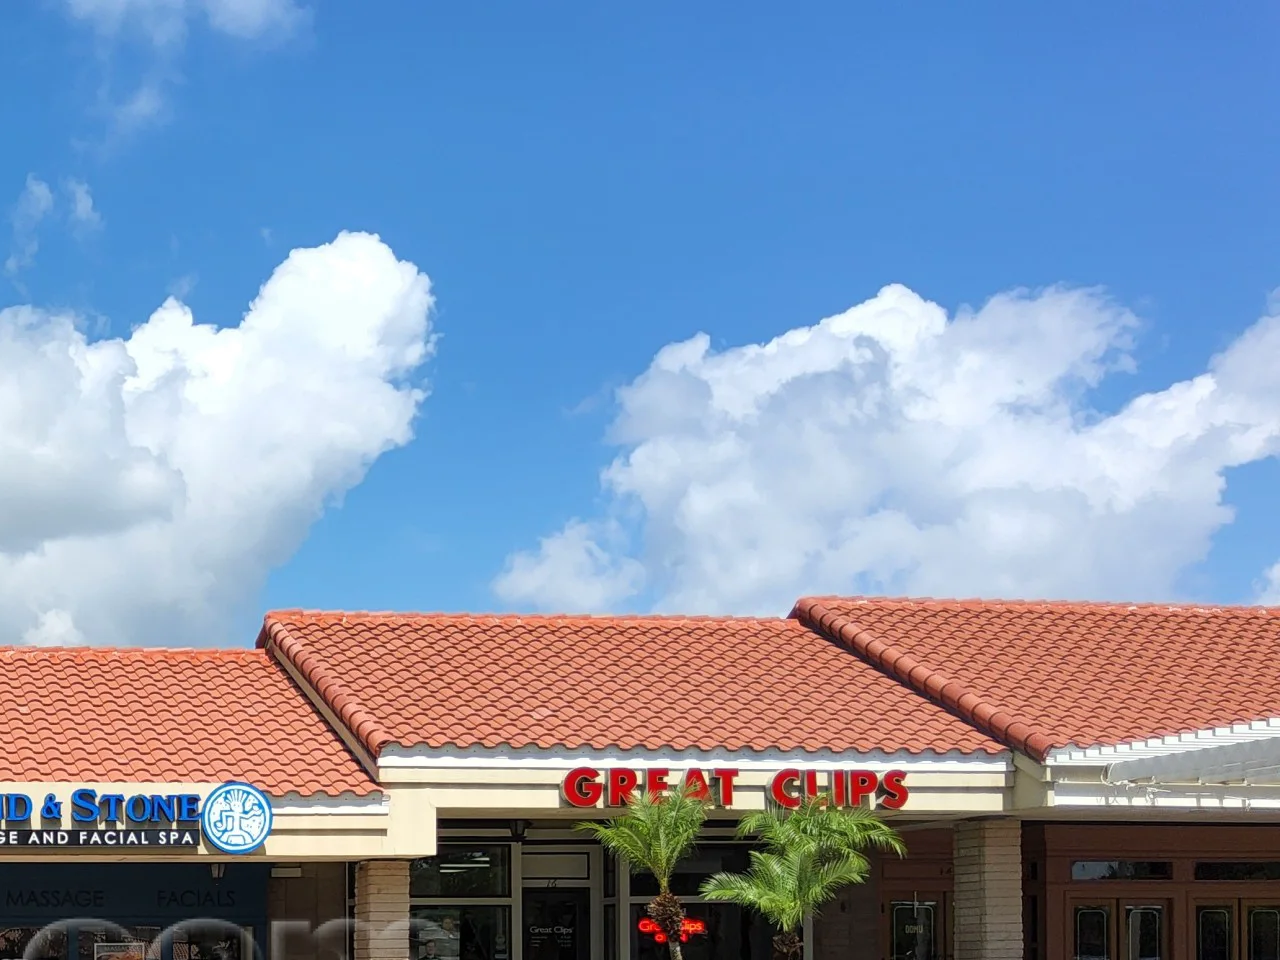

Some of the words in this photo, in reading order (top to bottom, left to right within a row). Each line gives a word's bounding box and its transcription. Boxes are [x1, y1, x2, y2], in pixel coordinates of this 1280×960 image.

[562, 766, 739, 808] GREAT
[770, 769, 910, 810] CLIPS
[42, 794, 62, 820] &
[70, 788, 201, 823] STONE
[27, 831, 69, 846] AND
[80, 831, 150, 846] FACIAL
[158, 831, 194, 846] SPA
[5, 889, 105, 908] MASSAGE
[156, 889, 236, 908] FACIALS
[529, 925, 553, 934] Great
[904, 924, 924, 934] DOMU
